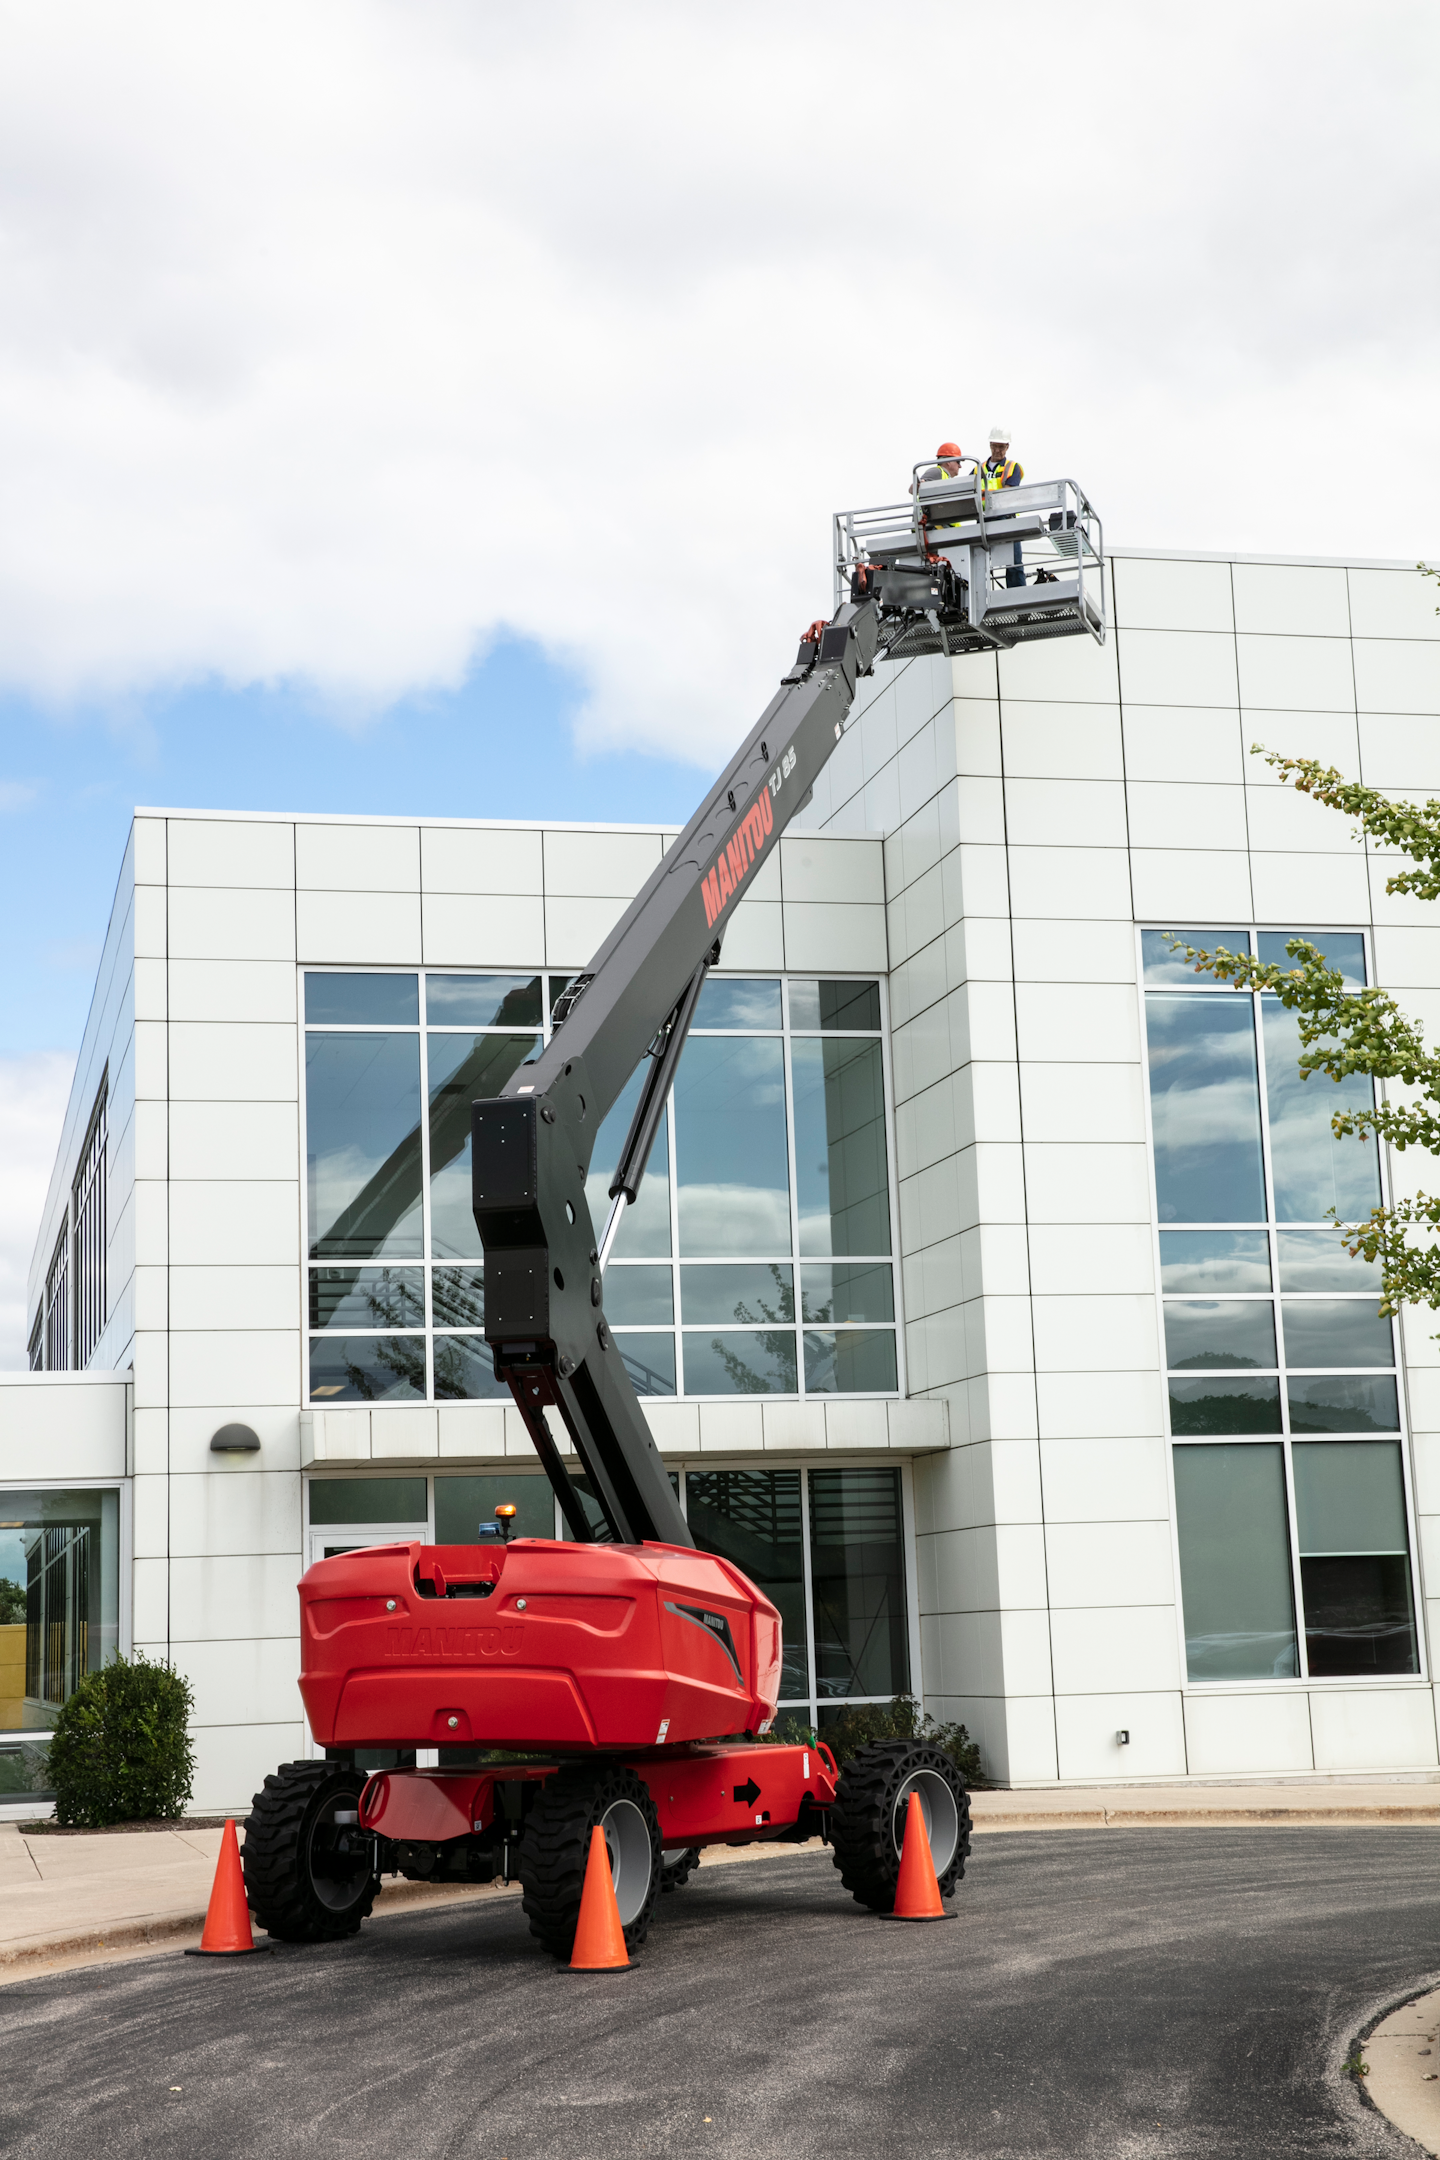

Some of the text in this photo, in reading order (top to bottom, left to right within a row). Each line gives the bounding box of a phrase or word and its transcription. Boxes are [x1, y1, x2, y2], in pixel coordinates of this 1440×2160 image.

[701, 745, 797, 929] MANITOU TJ 85
[704, 1614, 724, 1630] MANITOU
[384, 1626, 525, 1656] MANITOU
